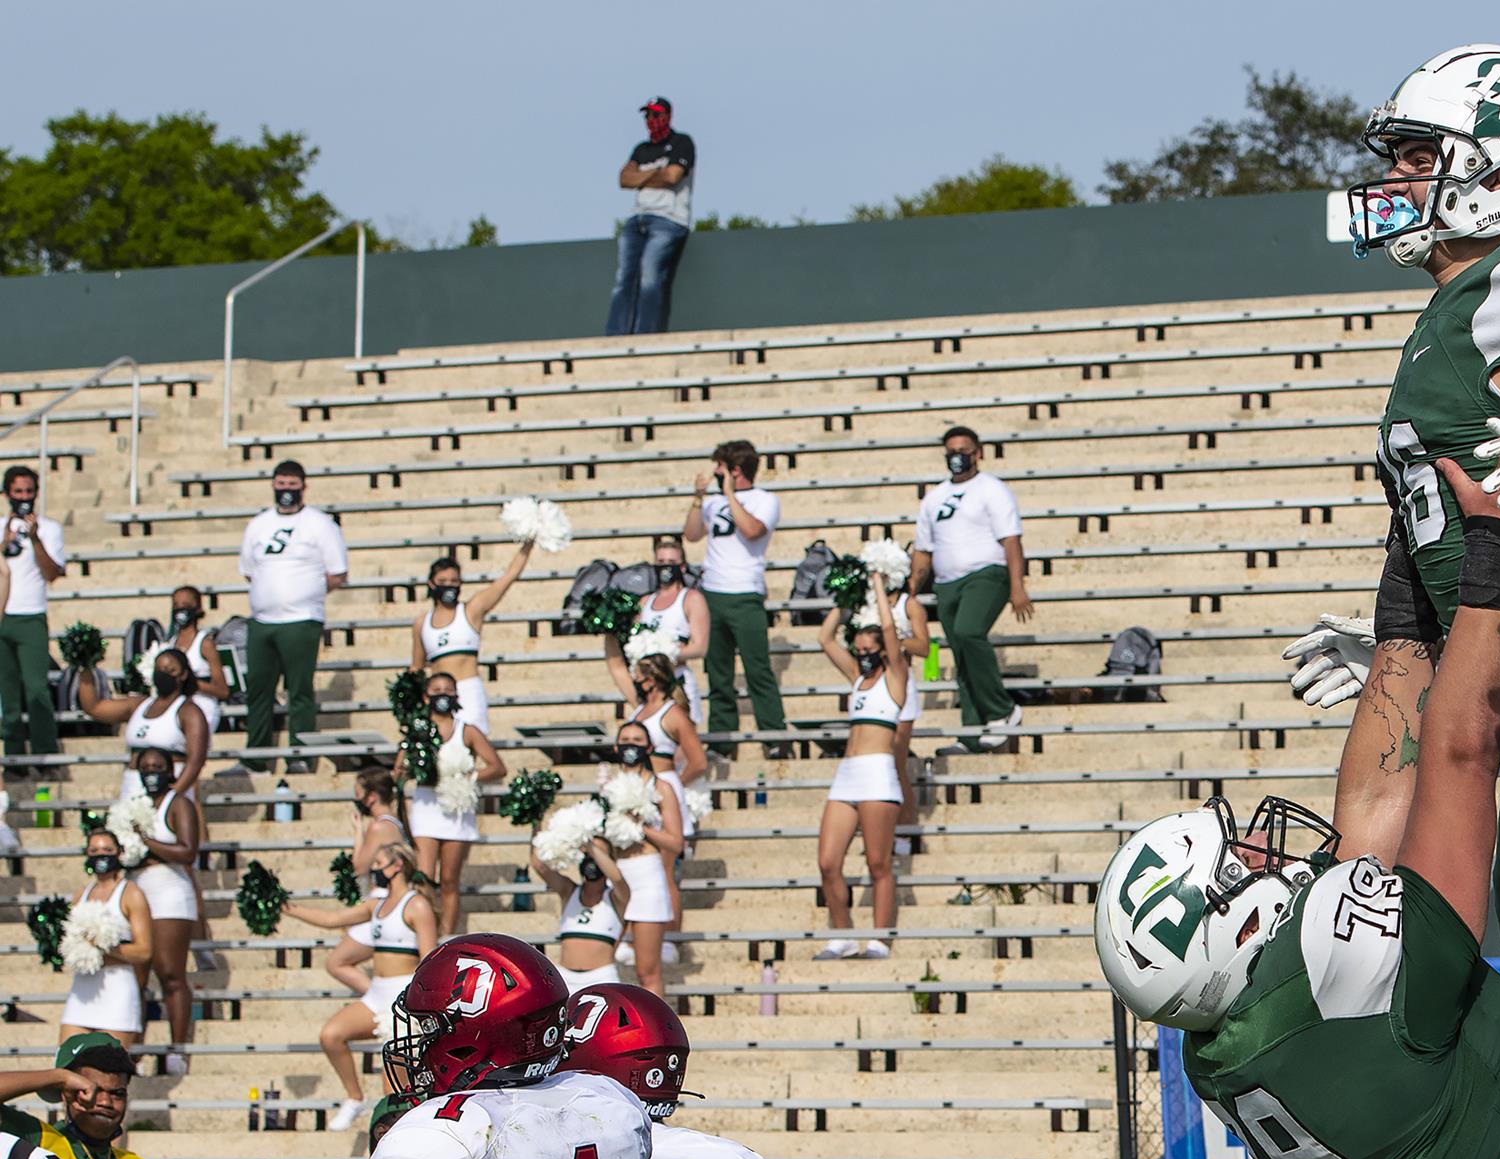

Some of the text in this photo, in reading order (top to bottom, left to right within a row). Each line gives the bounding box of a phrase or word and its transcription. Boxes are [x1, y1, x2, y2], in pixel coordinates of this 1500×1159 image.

[1378, 420, 1448, 550] 6
[265, 528, 294, 554] S
[577, 907, 594, 924] S
